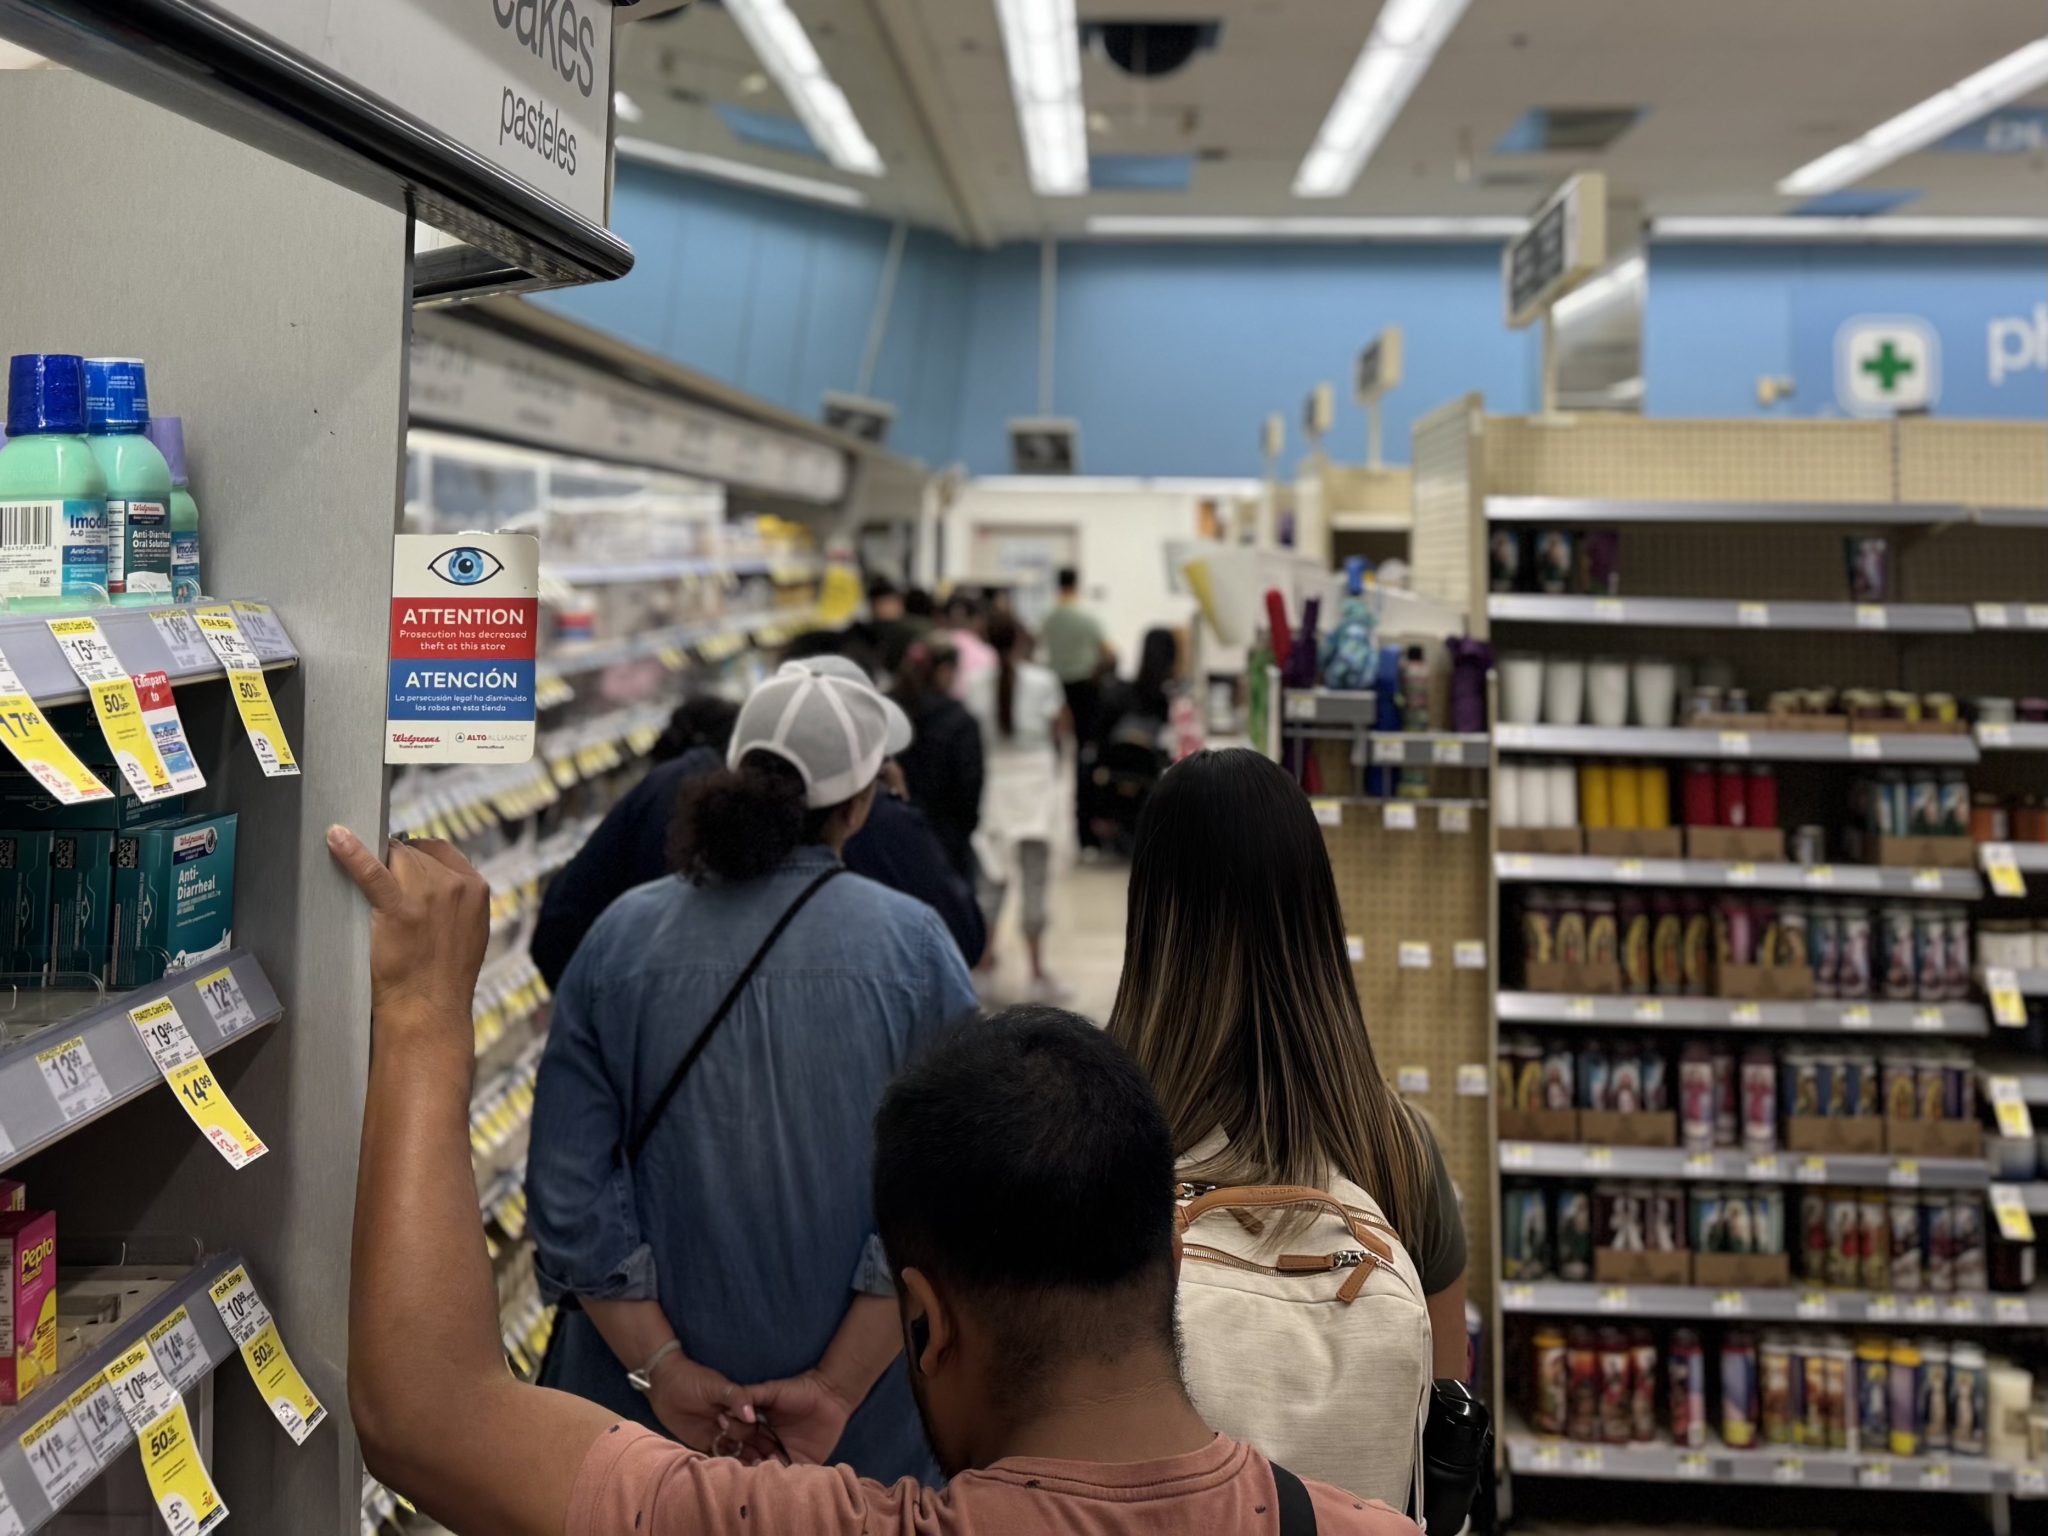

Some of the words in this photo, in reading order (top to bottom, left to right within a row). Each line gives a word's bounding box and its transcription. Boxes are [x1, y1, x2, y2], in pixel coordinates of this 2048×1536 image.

[500, 86, 577, 176] pasteles
[132, 540, 148, 548] Oral
[403, 608, 525, 625] ATTENTION
[399, 629, 457, 639] Prosecution
[458, 629, 475, 639] has
[478, 629, 527, 639] decreased
[420, 641, 445, 651] theft
[447, 642, 458, 651] at
[460, 641, 478, 651] this
[480, 642, 506, 651] store
[134, 673, 167, 689] Compare
[405, 667, 517, 688] ATENCIÓN
[150, 690, 160, 702] to
[395, 694, 405, 702] La
[406, 693, 452, 704] persecusión
[453, 694, 473, 704] legal
[473, 694, 484, 702] ha
[485, 694, 528, 702] disminuido
[415, 704, 427, 712] los
[428, 704, 450, 712] robos
[481, 704, 506, 712] tienda
[392, 733, 441, 746] Walgreens
[178, 865, 200, 884] Anti-
[177, 874, 216, 900] Diarrheal
[21, 1236, 55, 1274] Pepto
[214, 1282, 229, 1298] FSA
[110, 1360, 127, 1377] FSA
